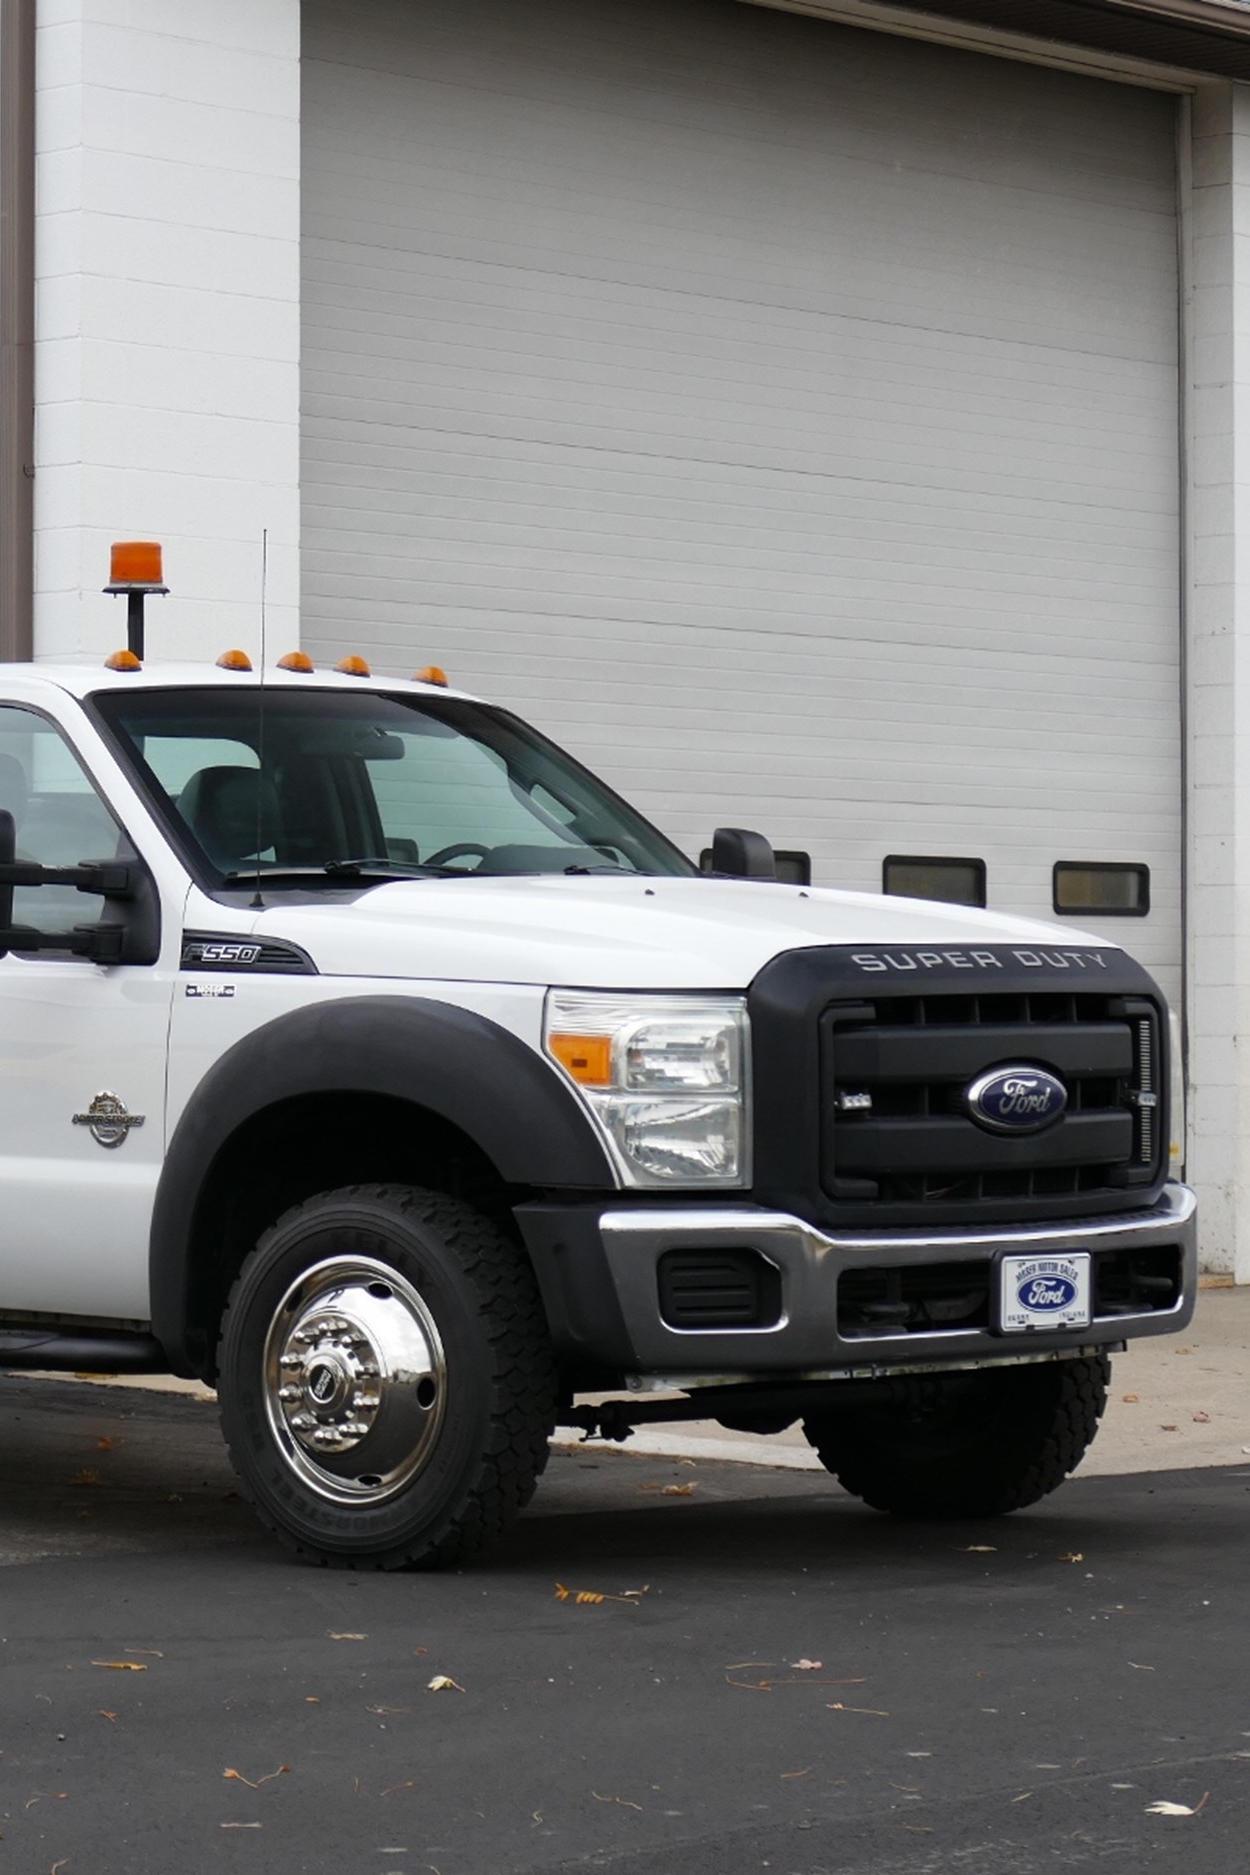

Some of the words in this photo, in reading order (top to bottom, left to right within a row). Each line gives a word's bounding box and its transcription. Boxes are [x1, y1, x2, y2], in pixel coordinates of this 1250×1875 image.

[851, 951, 1003, 972] SUPER
[1012, 950, 1107, 968] DUTY
[999, 1079, 1051, 1114] Ford
[1060, 1263, 1079, 1281] SALES
[1028, 1279, 1065, 1305] Ford
